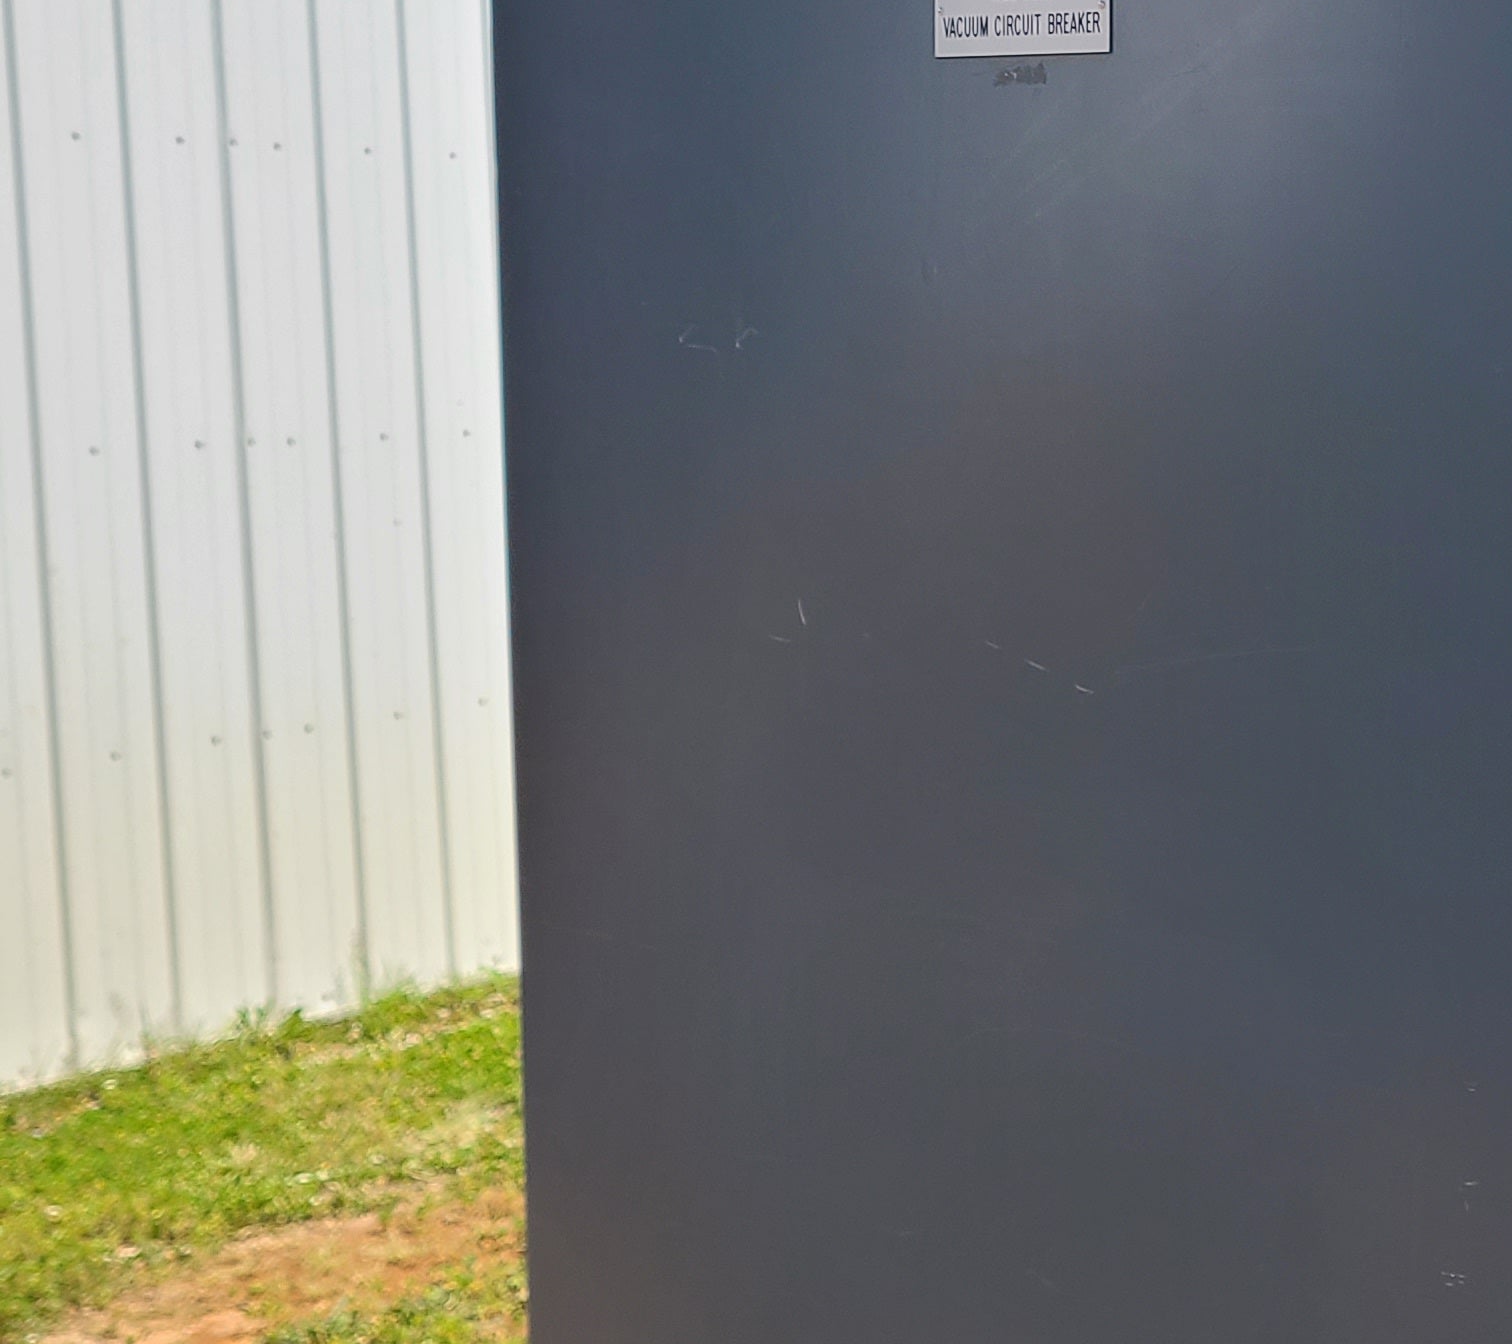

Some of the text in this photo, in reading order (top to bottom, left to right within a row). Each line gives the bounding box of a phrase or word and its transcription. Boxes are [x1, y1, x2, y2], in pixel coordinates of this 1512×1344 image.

[943, 11, 1101, 38] VACUUM CIRCUIT BREAKER
